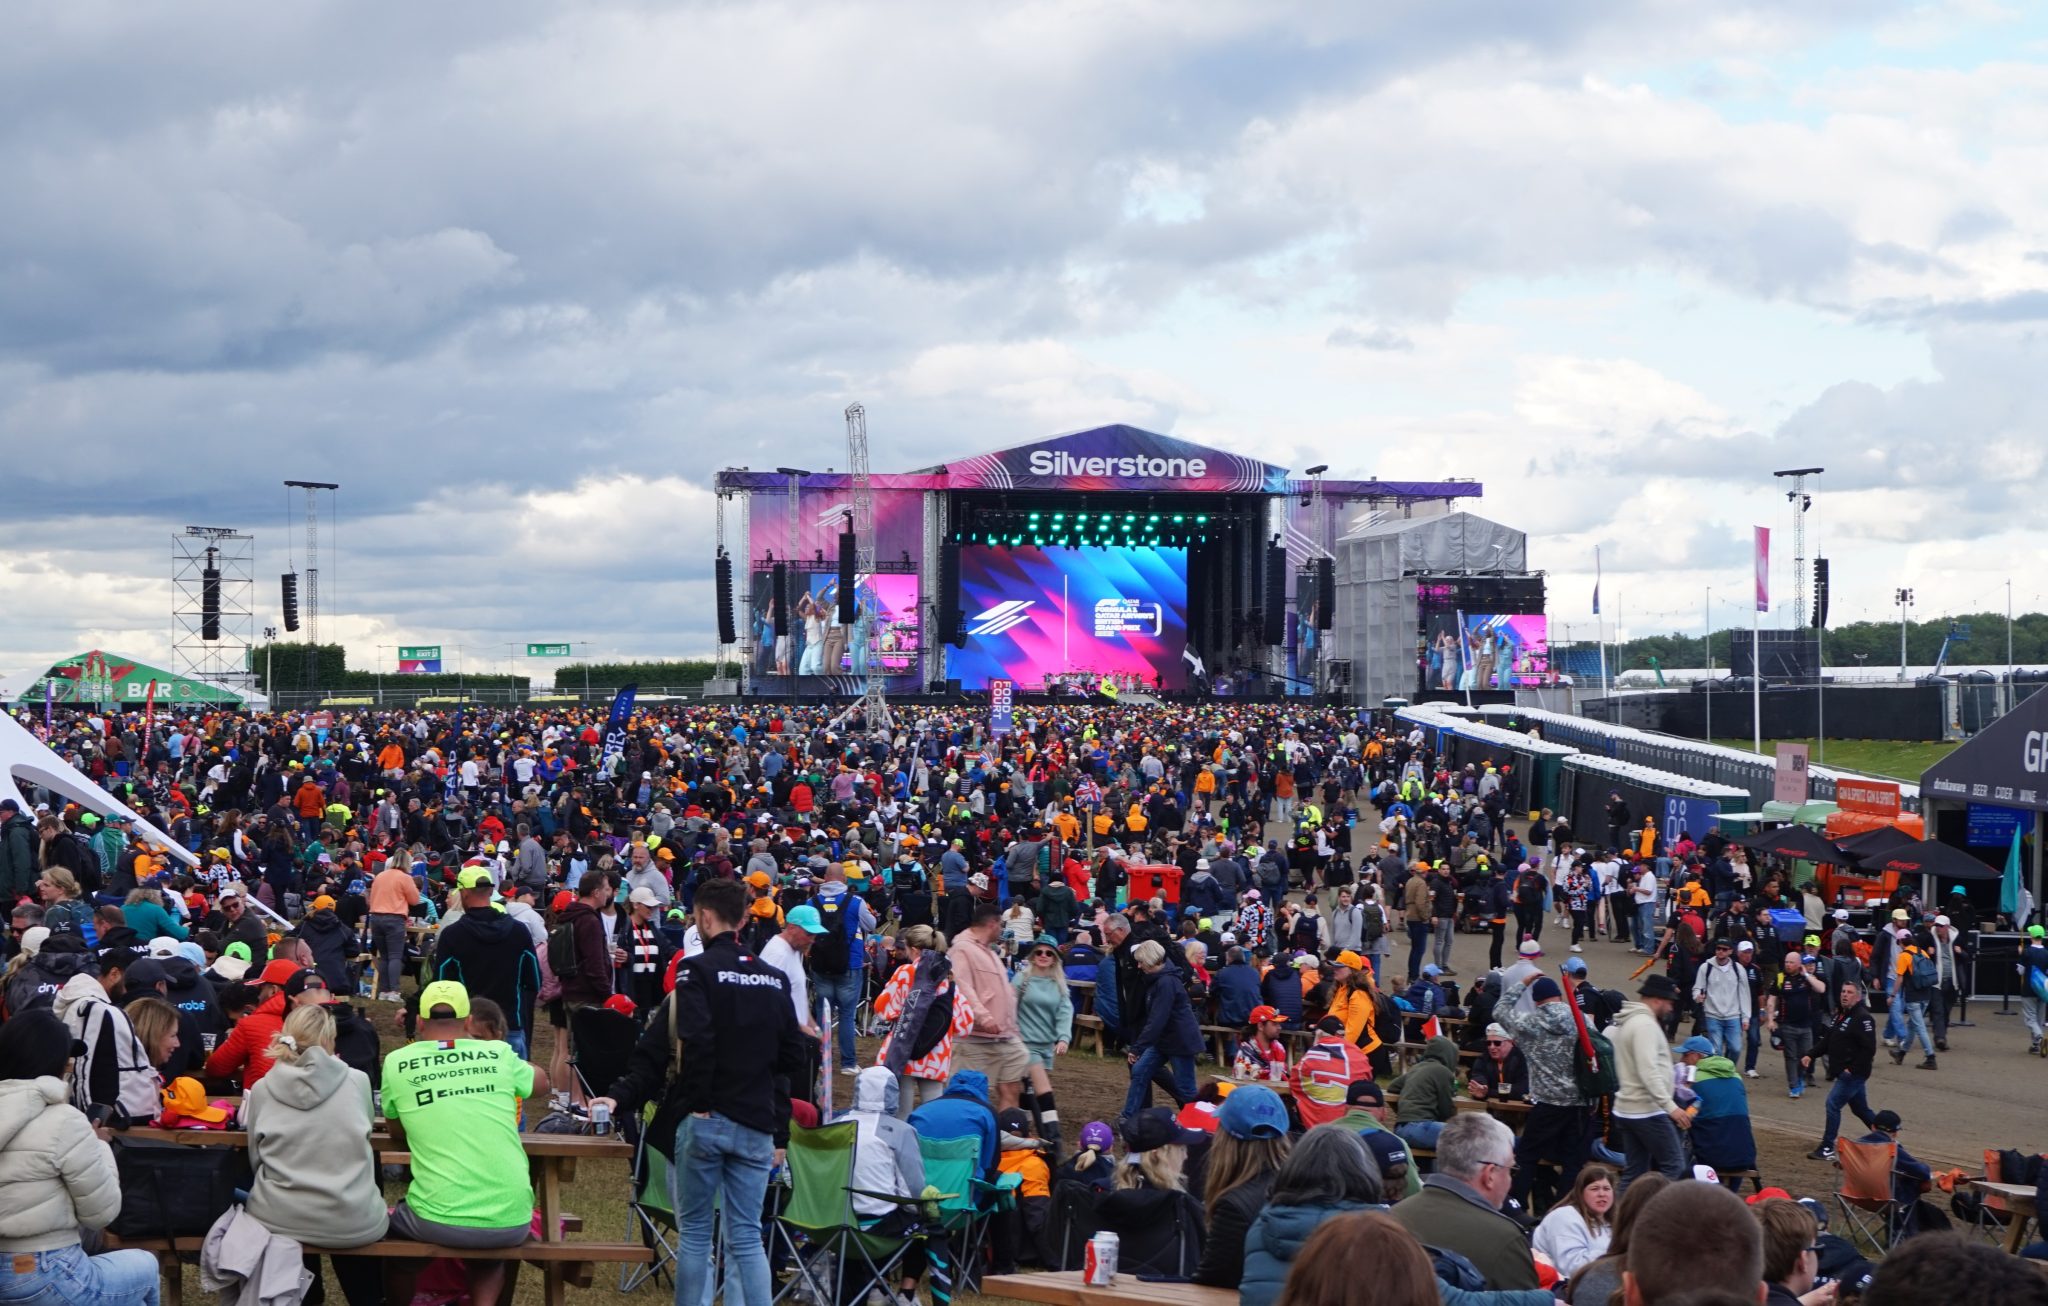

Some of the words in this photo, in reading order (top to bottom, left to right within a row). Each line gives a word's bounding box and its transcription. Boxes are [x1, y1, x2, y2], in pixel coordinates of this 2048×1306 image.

[1029, 451, 1207, 477] Silverstone
[127, 683, 172, 698] BAR
[1002, 680, 1012, 713] FOOD
[992, 680, 1003, 721] COURT
[1972, 784, 1988, 797] BEER
[1994, 786, 2013, 800] CIDER
[2020, 789, 2037, 803] WINE
[717, 971, 782, 990] PETRONAS
[398, 1050, 499, 1073] PETRONAS
[412, 1066, 498, 1085] CROWDSTRIKE
[437, 1084, 495, 1099] Einhell
